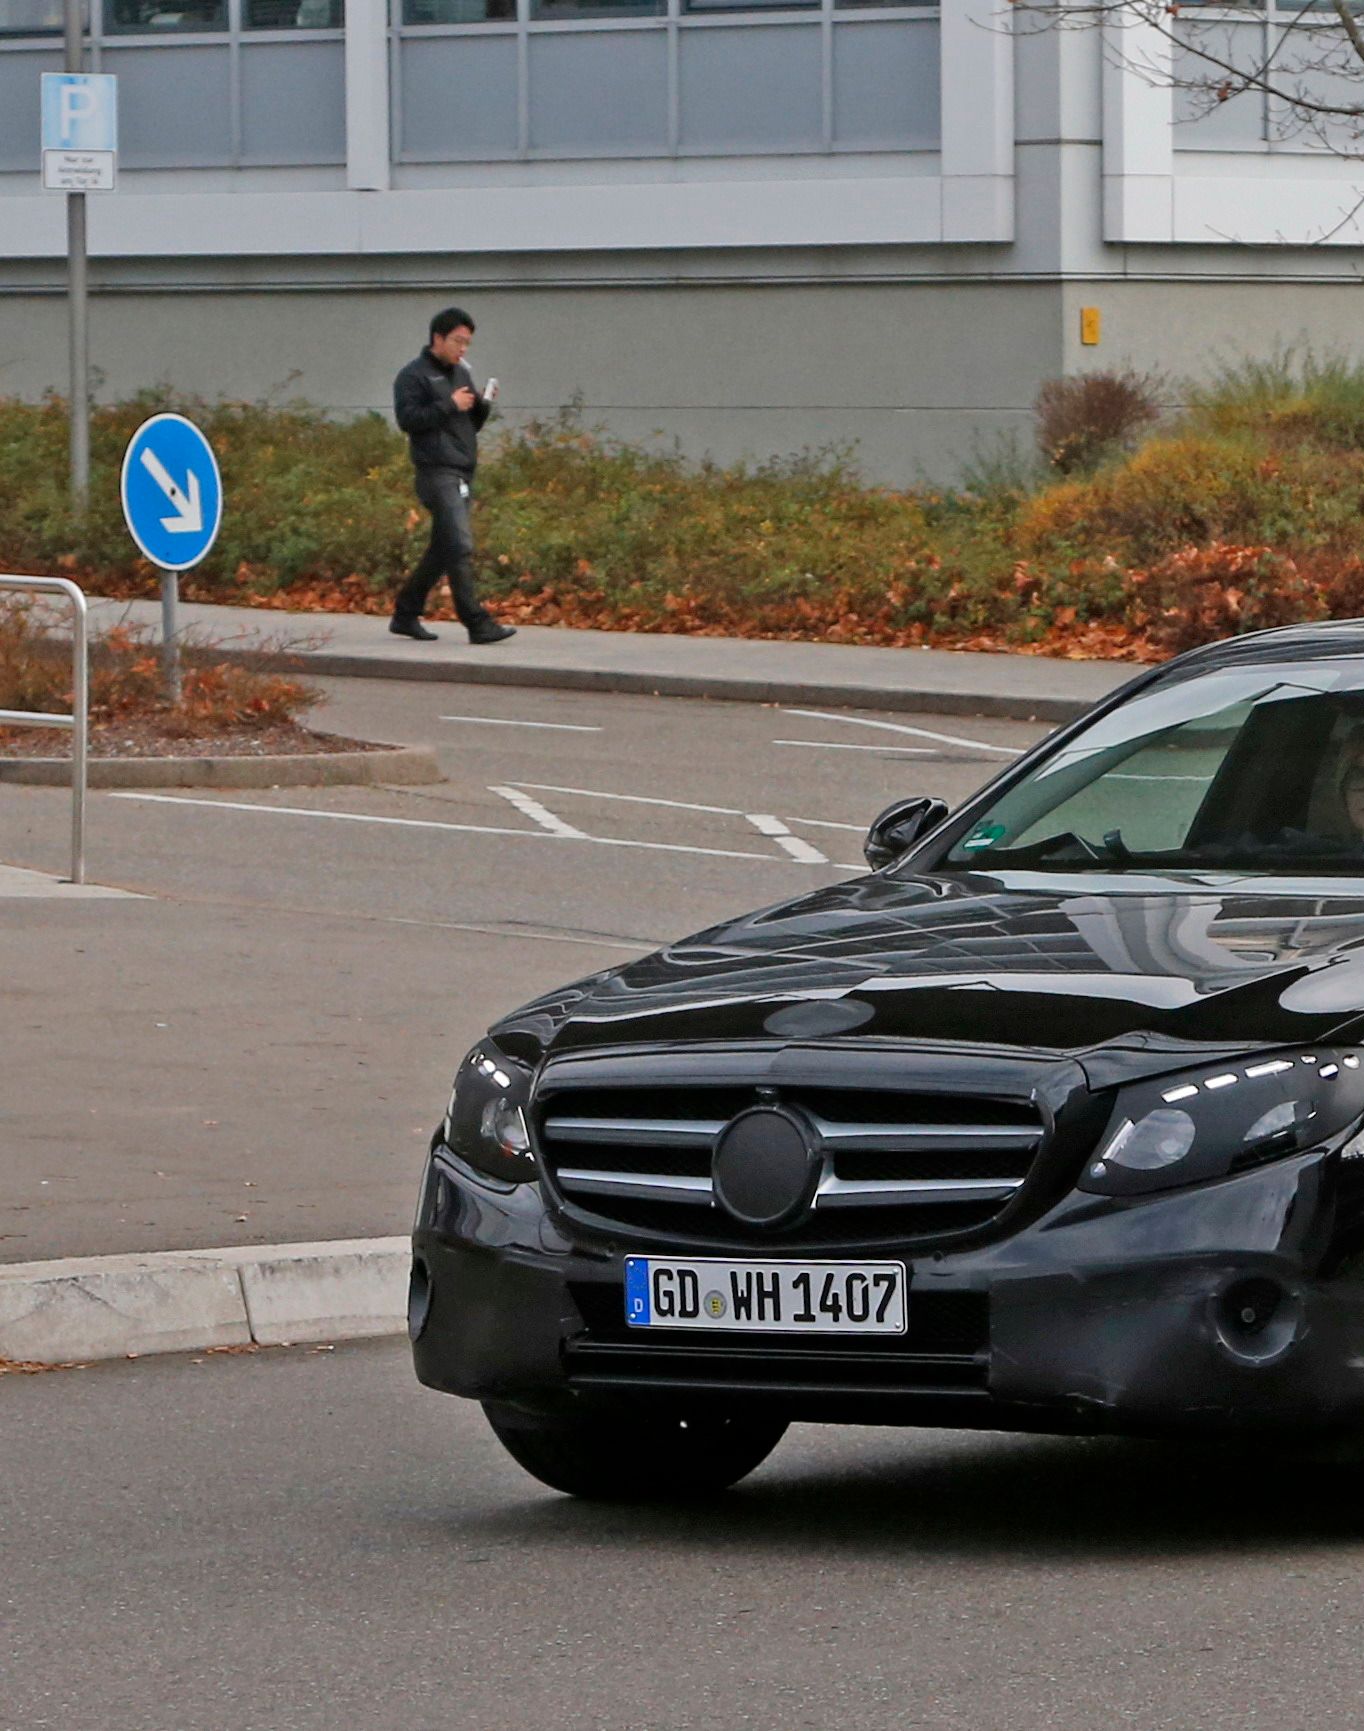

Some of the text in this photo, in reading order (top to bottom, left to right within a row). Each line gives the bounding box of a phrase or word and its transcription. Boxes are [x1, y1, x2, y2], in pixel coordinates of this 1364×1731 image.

[61, 84, 97, 139] P
[633, 1298, 644, 1313] D
[652, 1268, 898, 1323] GD WH 1407
